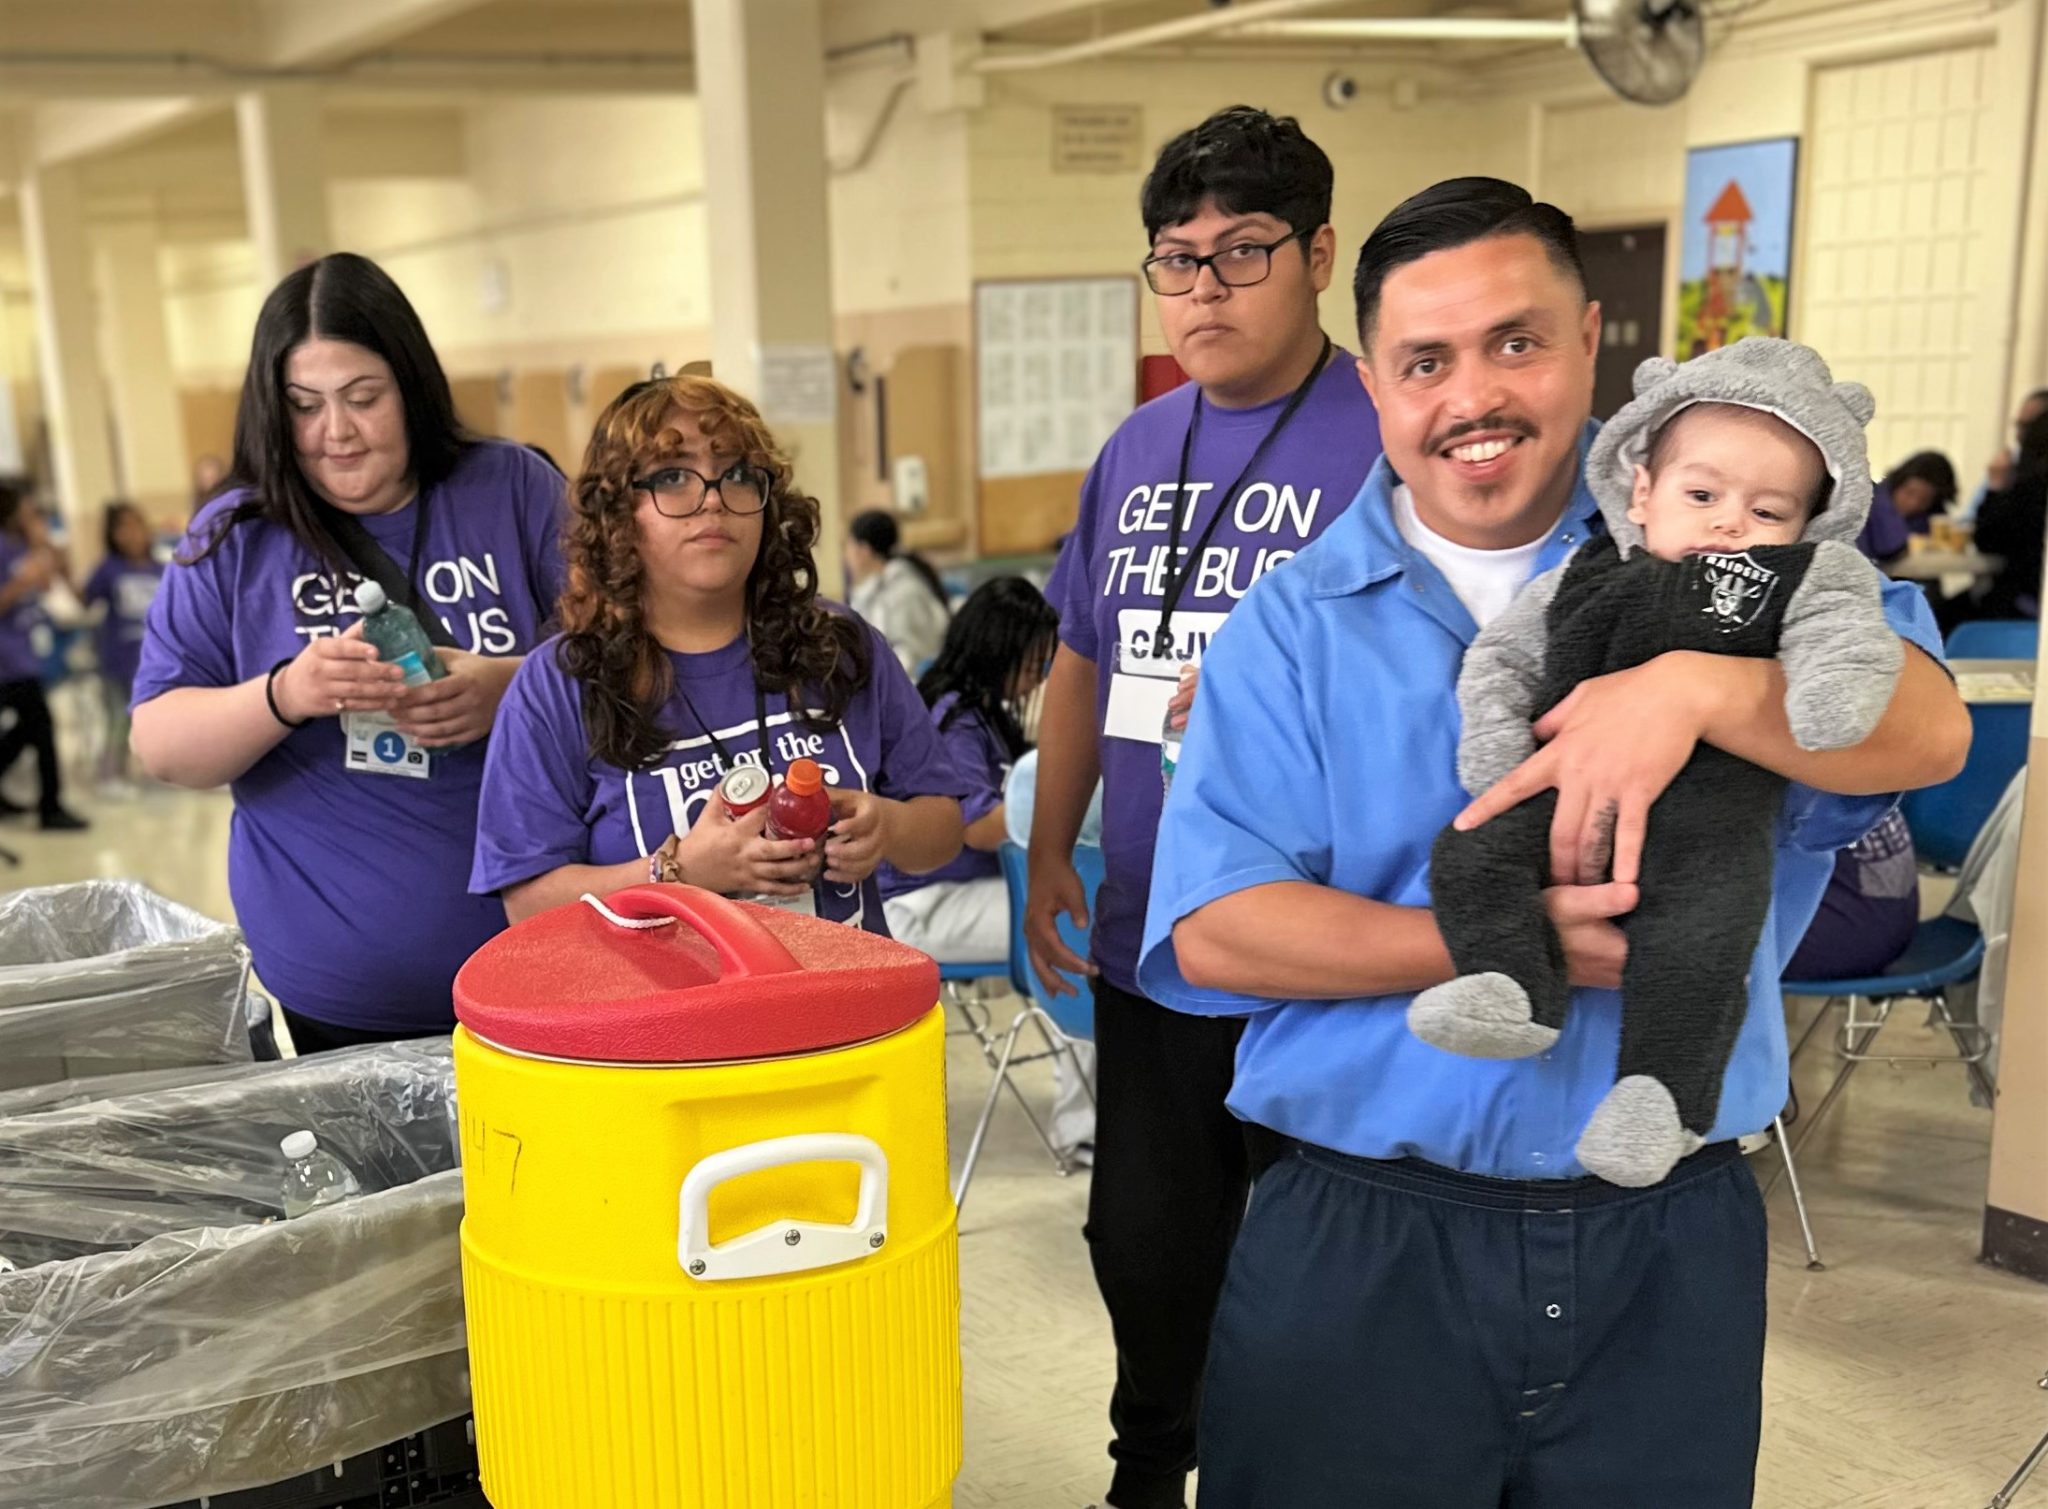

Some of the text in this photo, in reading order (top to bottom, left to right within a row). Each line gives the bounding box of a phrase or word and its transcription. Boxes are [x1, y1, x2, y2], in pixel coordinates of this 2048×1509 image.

[1118, 482, 1321, 538] GET ON
[425, 553, 501, 604] ON
[1104, 545, 1188, 597] THE
[1705, 556, 1771, 583] RAIDERS
[383, 737, 397, 758] 1
[680, 752, 728, 790] get
[775, 731, 825, 763] the
